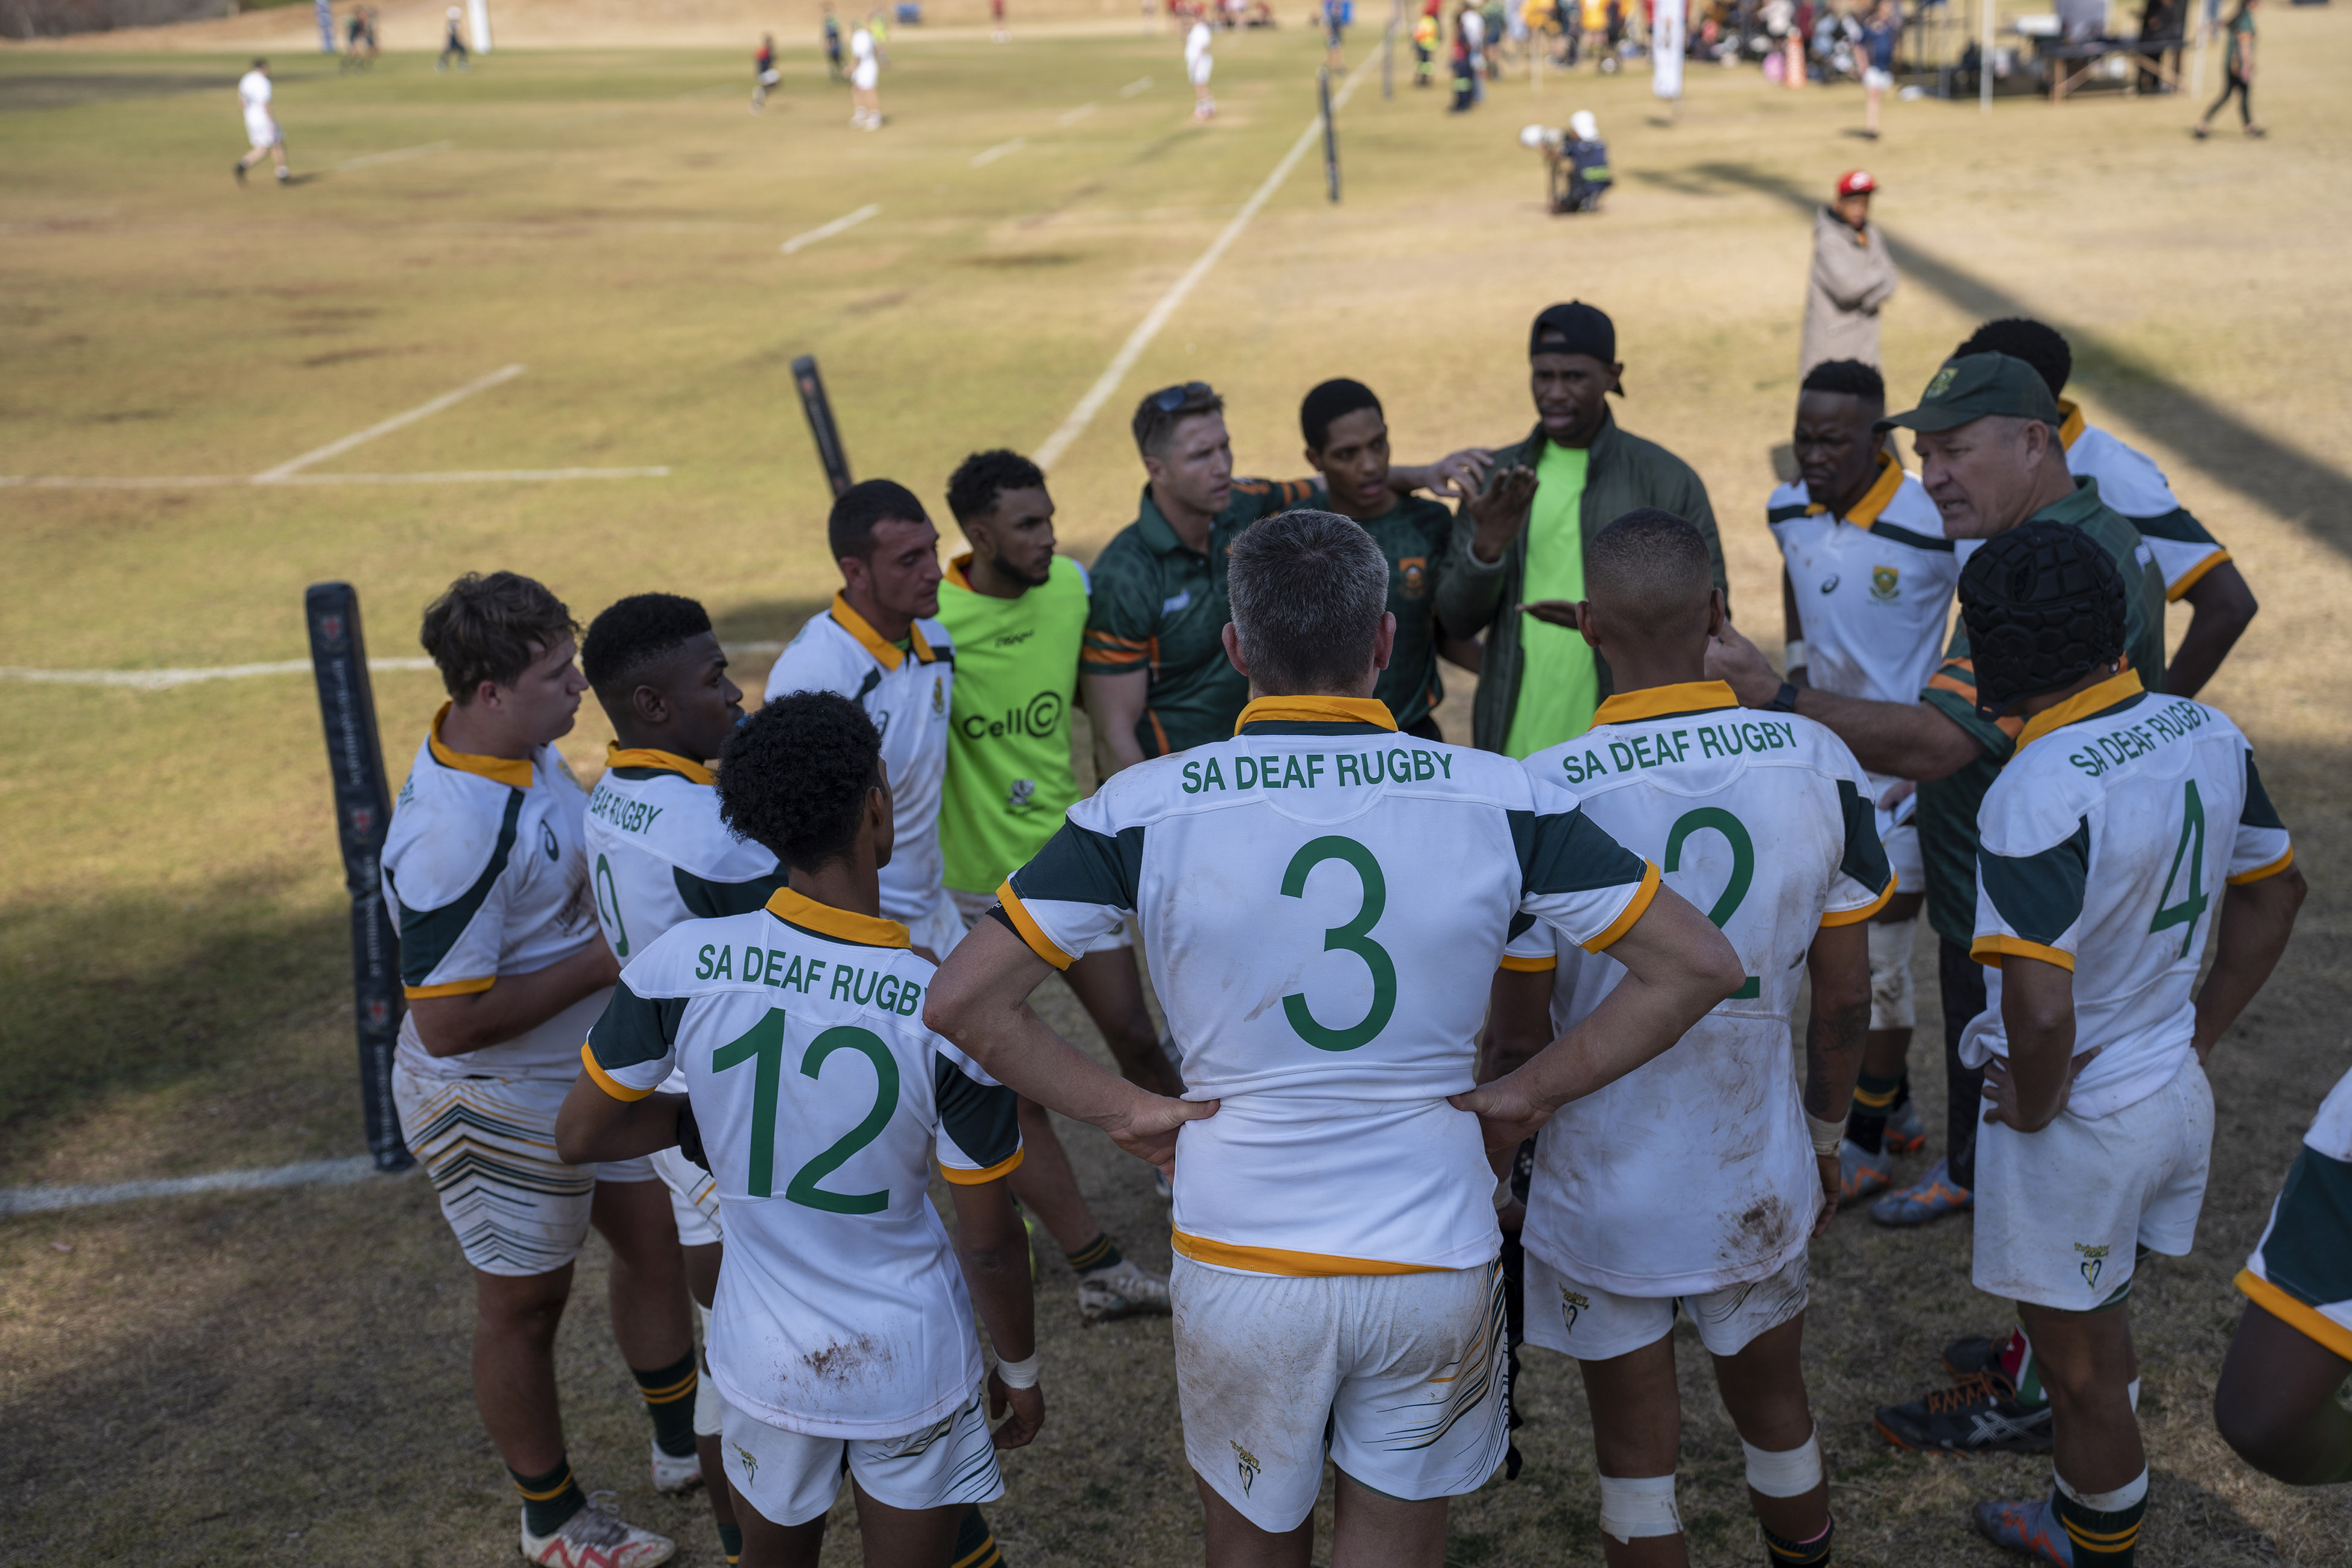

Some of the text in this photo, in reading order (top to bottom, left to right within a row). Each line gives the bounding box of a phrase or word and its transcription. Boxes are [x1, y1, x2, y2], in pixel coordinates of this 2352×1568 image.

[1182, 748, 1453, 794] SA DEAF RUGBY
[1563, 722, 1797, 784] SA DEAF RUGBY
[2069, 701, 2211, 777] SA DEAF RUGBY
[1664, 806, 1760, 1000] 2
[2149, 779, 2209, 959] 4
[695, 944, 929, 1020] SA DEAF RUGB
[1280, 835, 1397, 1052] 3
[712, 1007, 900, 1215] 12
